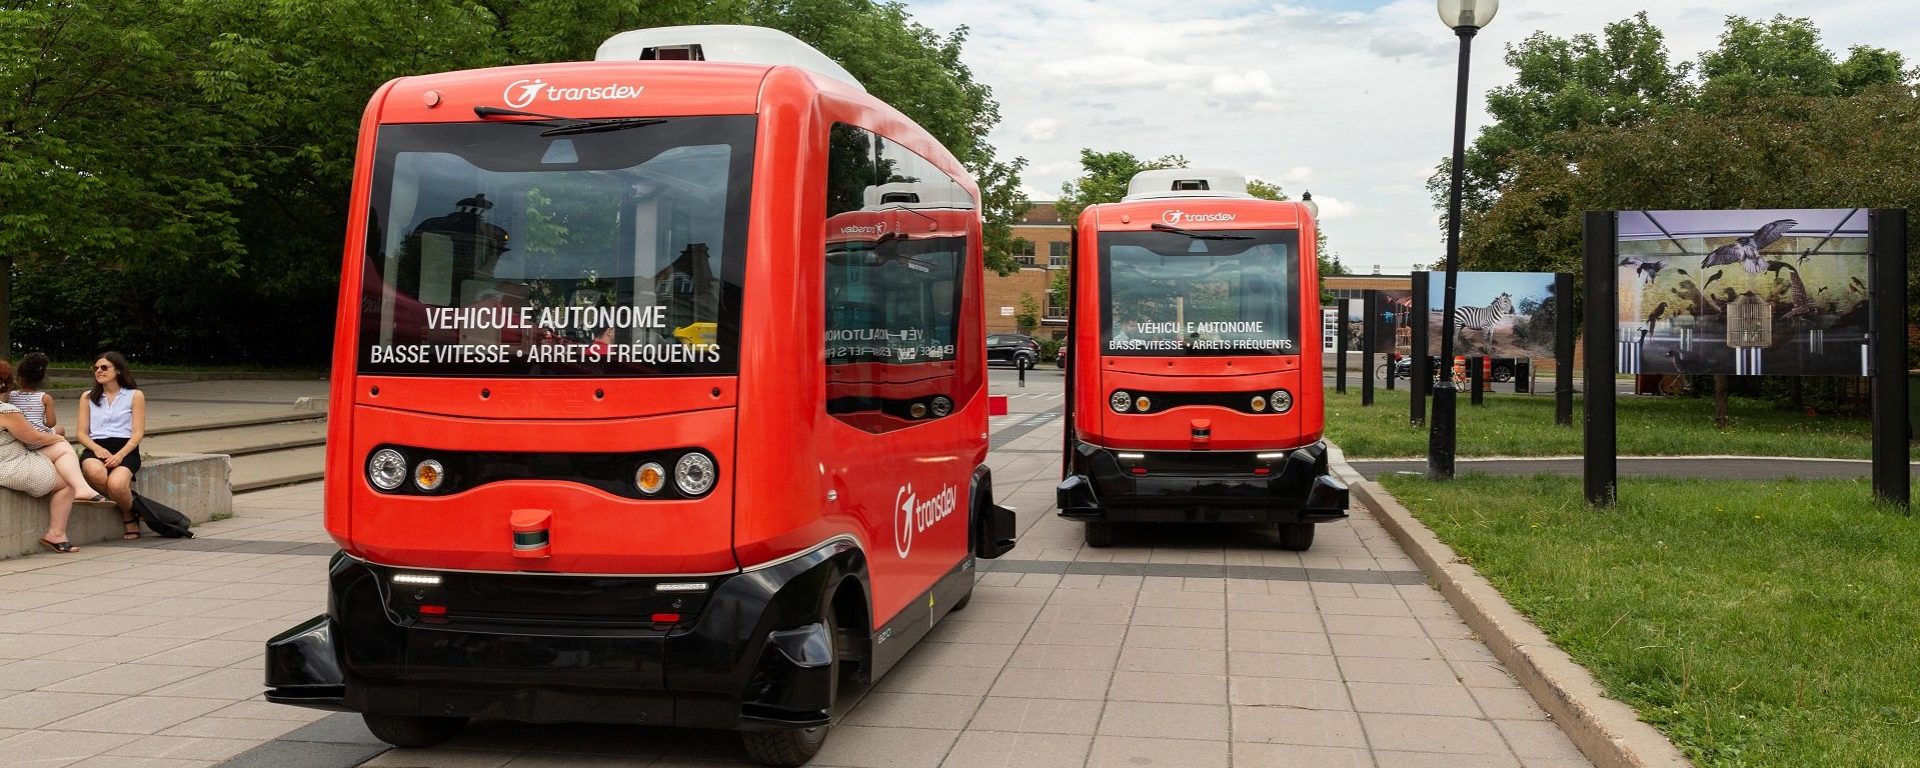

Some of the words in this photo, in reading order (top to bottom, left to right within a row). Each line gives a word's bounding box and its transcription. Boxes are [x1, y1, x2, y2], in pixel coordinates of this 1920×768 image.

[546, 83, 644, 101] transdev
[1184, 212, 1237, 222] transdev
[425, 306, 534, 330] VEHICULE
[538, 305, 668, 329] AUTONOME
[1137, 319, 1195, 334] VÉHICUE
[1197, 321, 1264, 333] AUTONOME
[370, 344, 430, 364] BASSE
[434, 344, 510, 364] VITESSE
[526, 343, 601, 363] ARRETS
[606, 339, 721, 365] FRÉQUENTS
[1109, 340, 1142, 350] BASSE
[1144, 340, 1184, 350] VITESSE
[1233, 337, 1293, 350] FRÉQUENTS
[915, 482, 957, 533] transdev
